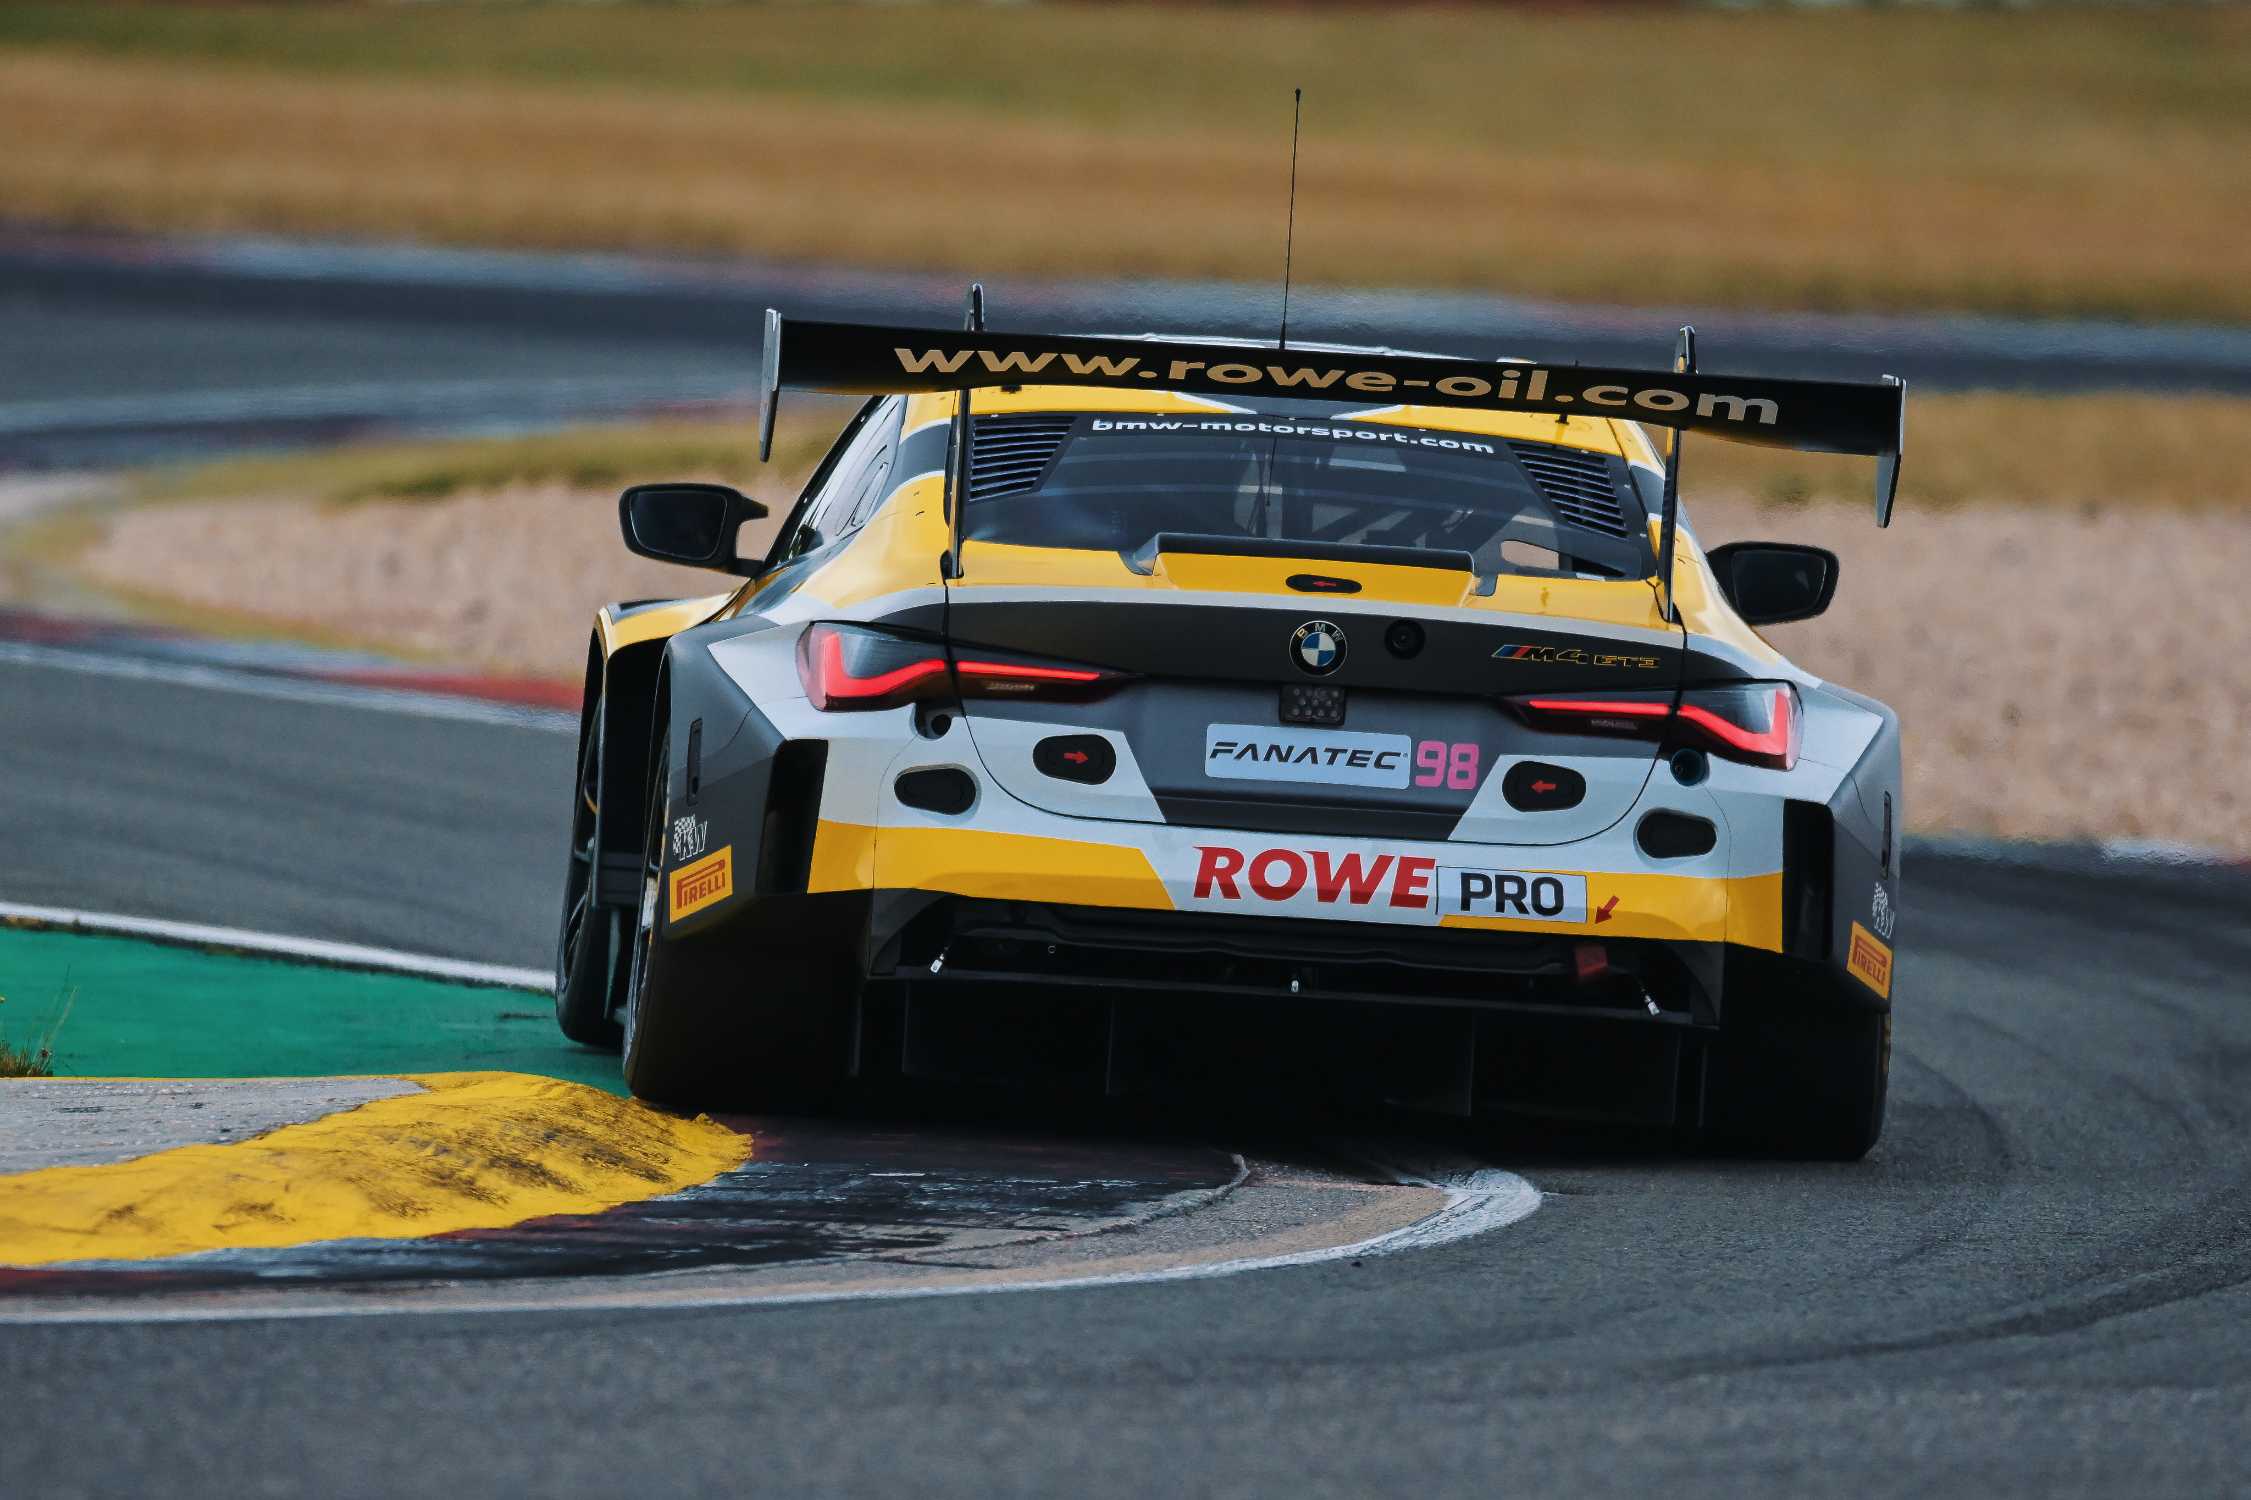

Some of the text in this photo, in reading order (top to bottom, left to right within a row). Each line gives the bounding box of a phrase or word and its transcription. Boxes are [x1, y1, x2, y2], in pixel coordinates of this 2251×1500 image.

[893, 347, 1780, 426] www.rowe-oil.com
[1091, 418, 1496, 455] bmw-motorsport.com
[1296, 622, 1344, 642] BMW
[1593, 654, 1662, 670] GT3
[1414, 739, 1481, 790] 98
[676, 858, 727, 911] PIRELLI
[1192, 845, 1438, 910] ROWE
[1459, 871, 1565, 917] PRO
[1853, 936, 1888, 985] PIRELLI
